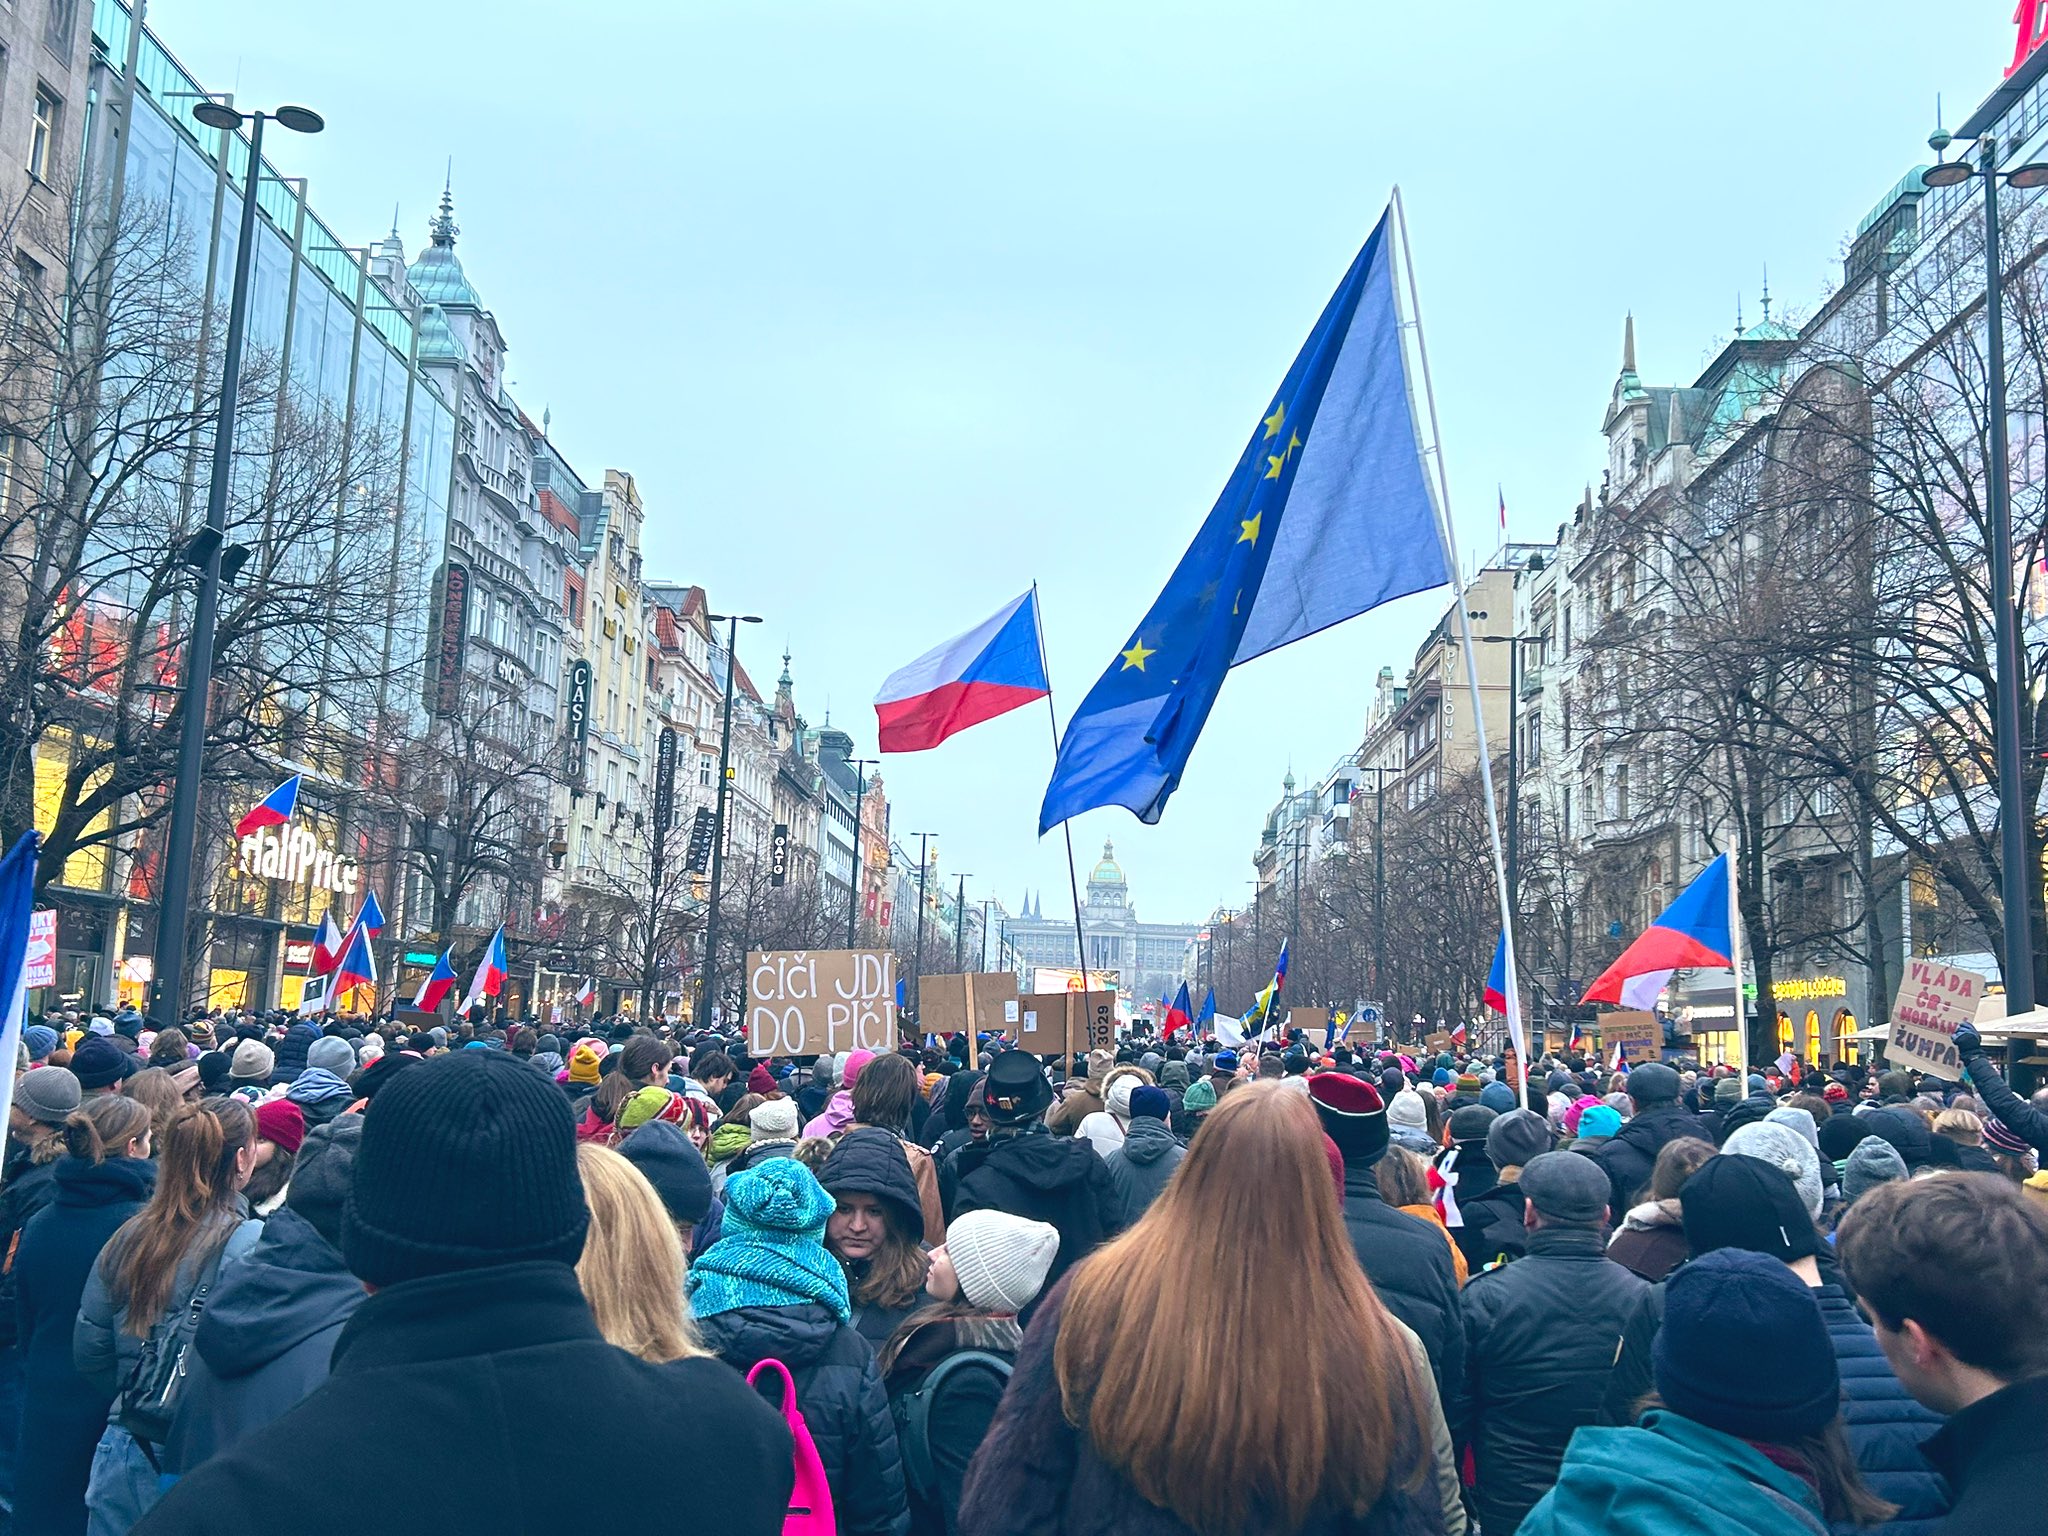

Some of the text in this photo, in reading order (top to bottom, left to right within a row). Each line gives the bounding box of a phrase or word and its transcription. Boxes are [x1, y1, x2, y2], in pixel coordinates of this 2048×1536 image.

[567, 667, 586, 776] CASINO
[240, 823, 358, 895] HalfPrice
[697, 817, 715, 870] RESERVED
[752, 952, 893, 1000] ČIČI JDI
[1911, 962, 1972, 997] VLÁDA
[751, 1005, 806, 1055] DO
[1097, 1005, 1109, 1045] 3029
[1899, 1005, 1968, 1034] MORÁLN
[1894, 1025, 1962, 1069] ŽUMPA.
